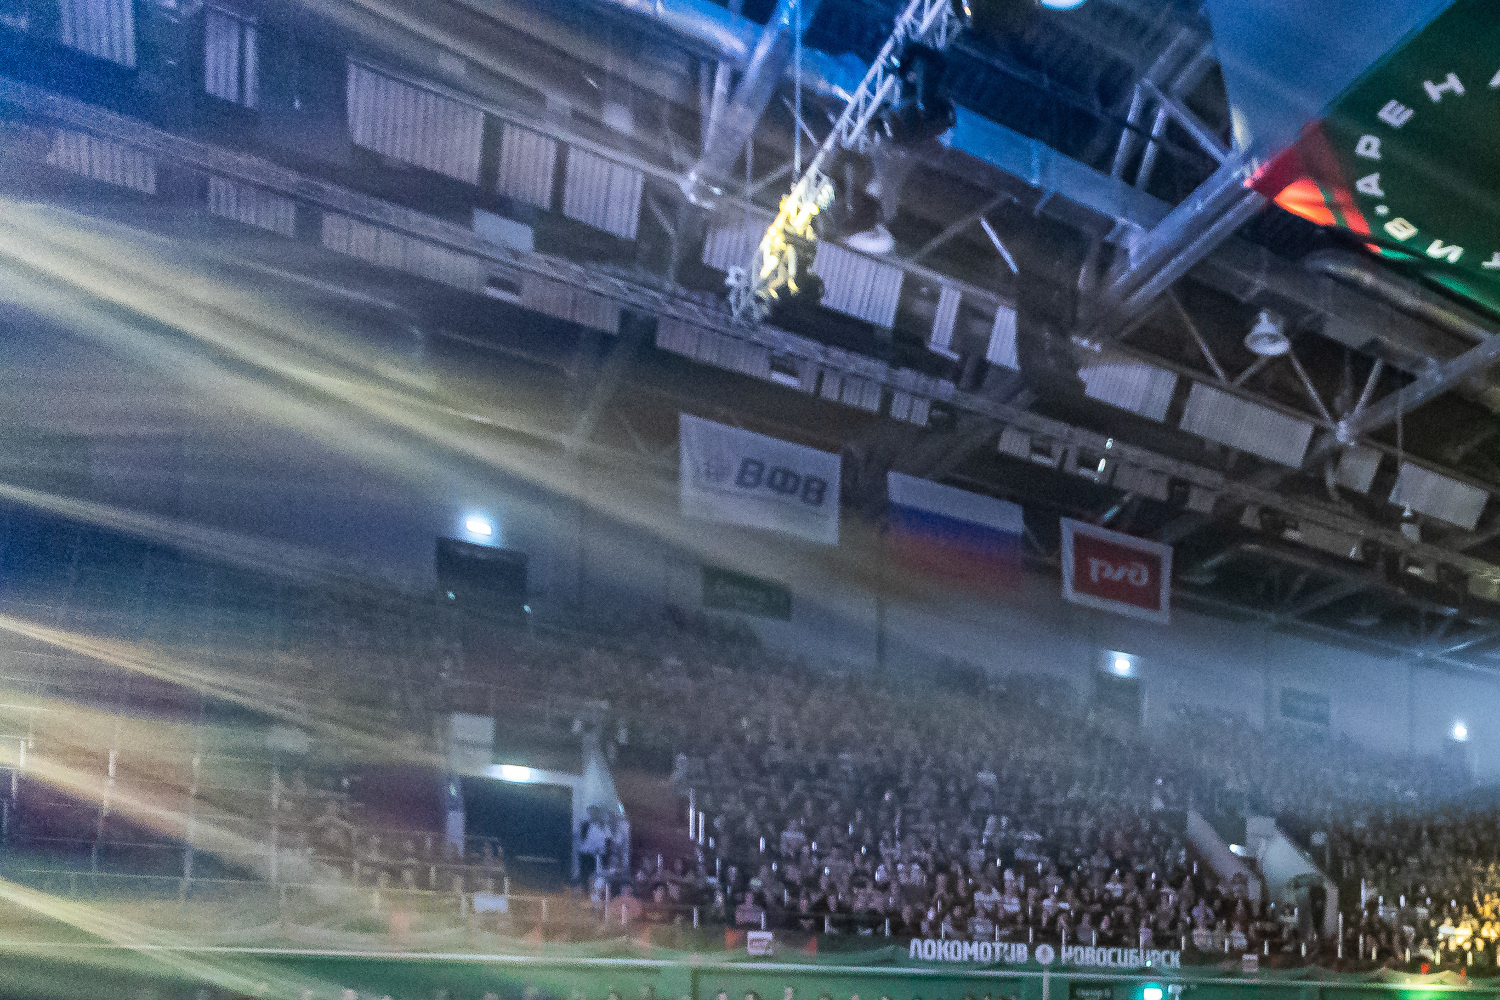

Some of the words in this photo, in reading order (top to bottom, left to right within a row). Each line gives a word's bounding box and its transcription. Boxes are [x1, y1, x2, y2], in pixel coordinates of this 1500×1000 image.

[735, 457, 829, 507] ВФВ
[909, 938, 1029, 964] ЛОКОМОТИВ
[1060, 944, 1181, 969] НОВОСИБИРСК
